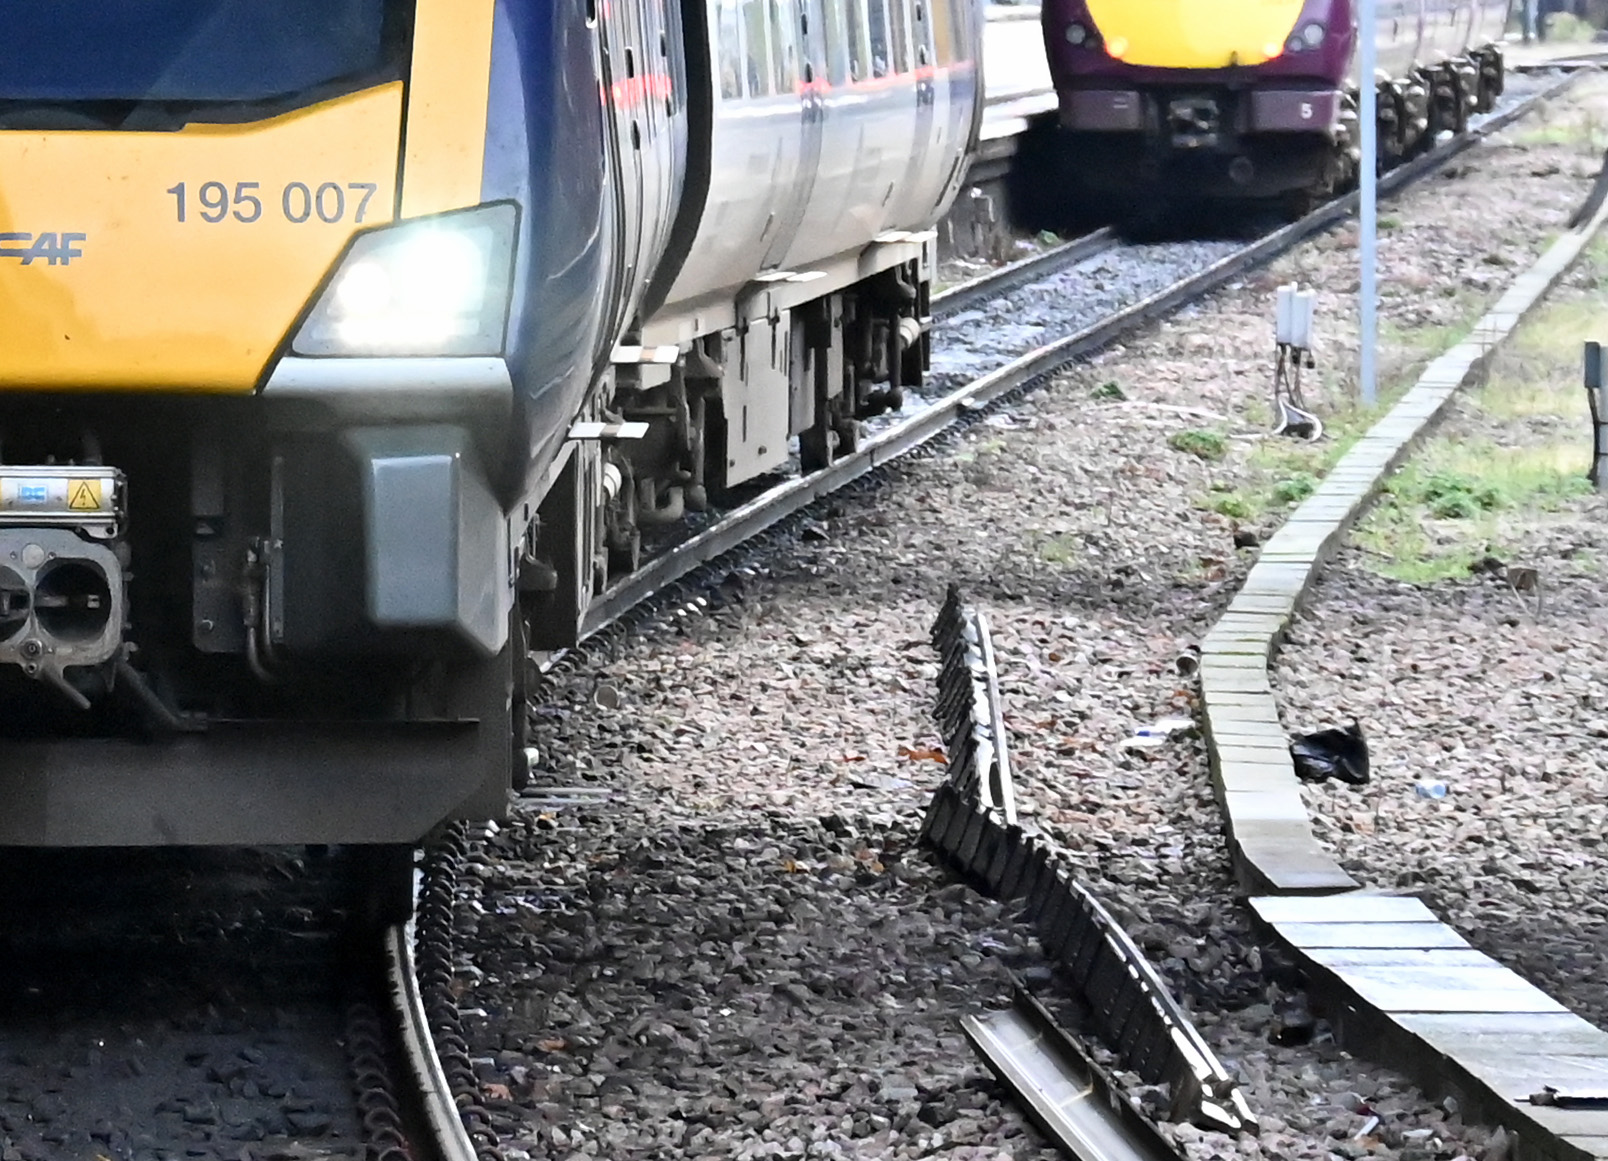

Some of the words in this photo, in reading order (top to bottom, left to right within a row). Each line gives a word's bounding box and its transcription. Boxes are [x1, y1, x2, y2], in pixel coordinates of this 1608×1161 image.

[1301, 102, 1313, 119] 5
[167, 181, 262, 223] 195
[282, 181, 377, 224] 007
